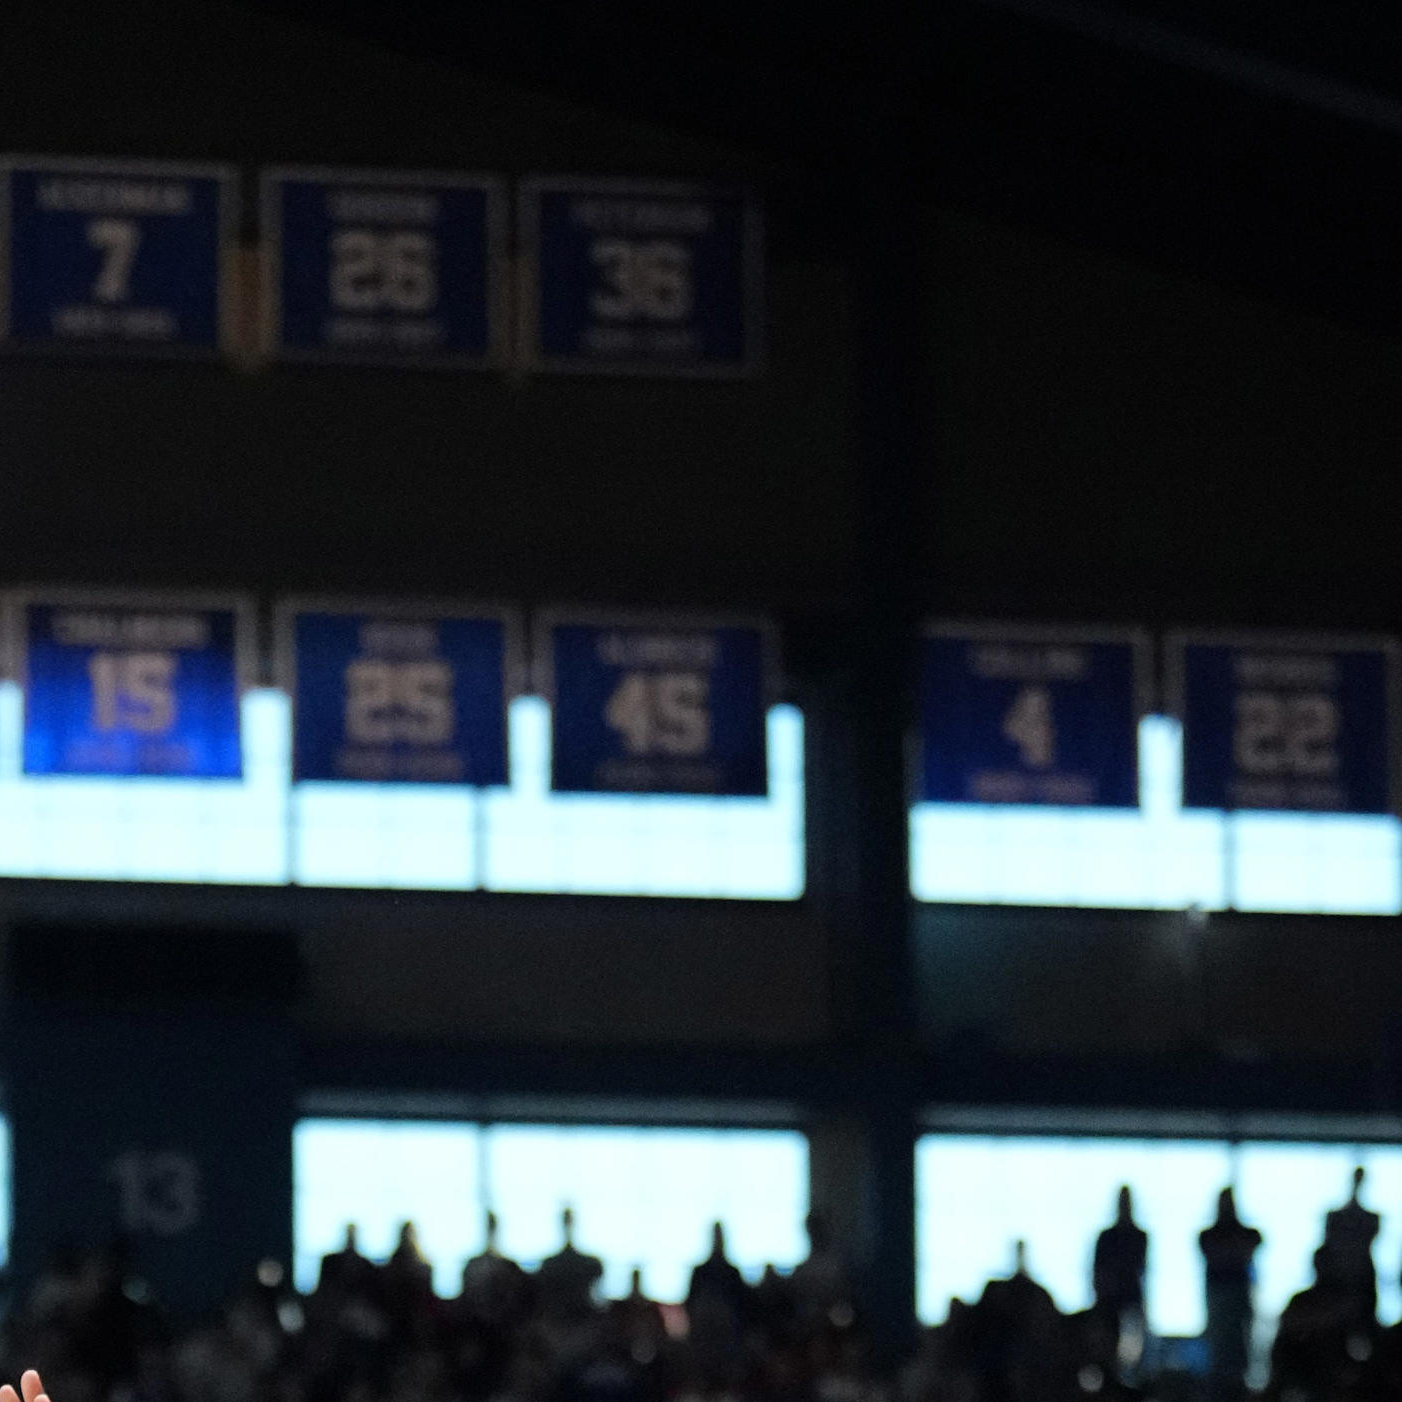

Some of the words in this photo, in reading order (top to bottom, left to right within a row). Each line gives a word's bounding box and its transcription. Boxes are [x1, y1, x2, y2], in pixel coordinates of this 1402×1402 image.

[85, 218, 142, 302] 7
[89, 653, 180, 736] 15
[605, 669, 712, 753] 45
[1004, 687, 1054, 768] 4
[1233, 693, 1342, 776] 22
